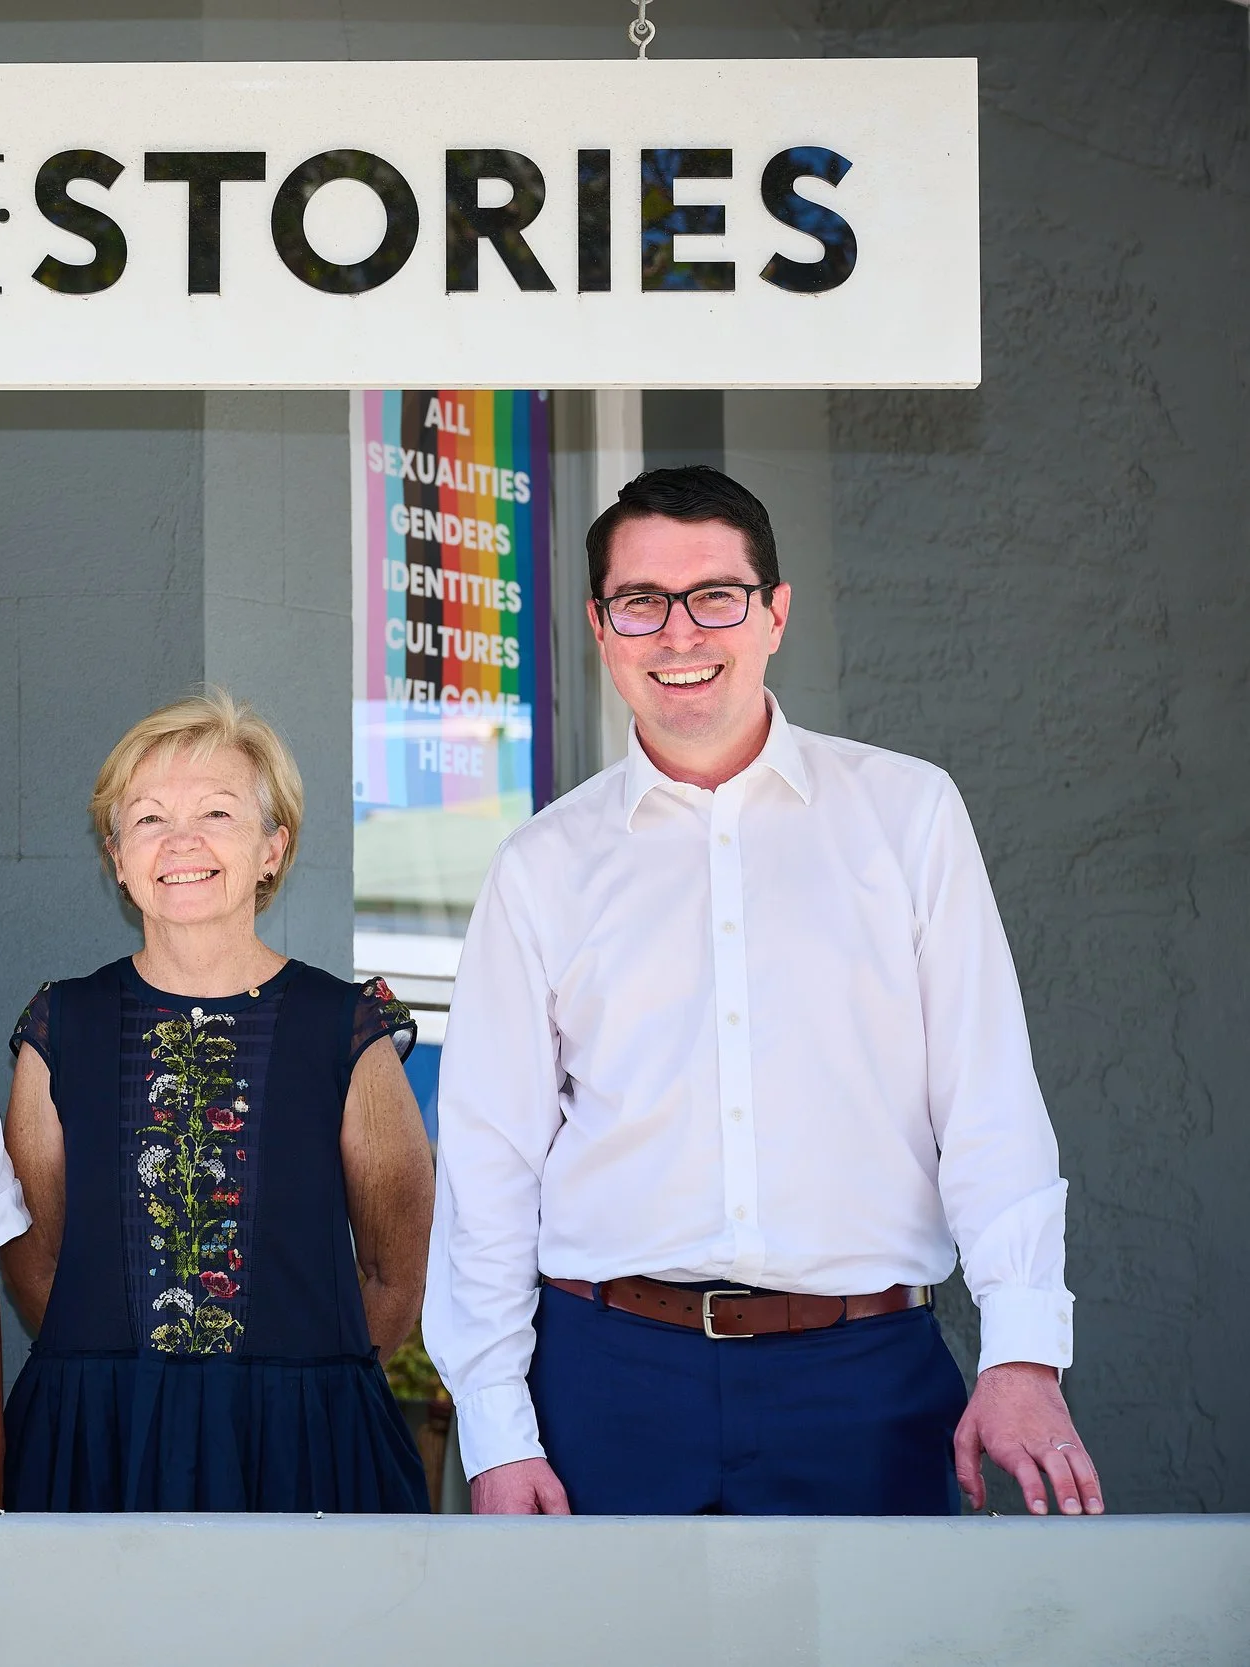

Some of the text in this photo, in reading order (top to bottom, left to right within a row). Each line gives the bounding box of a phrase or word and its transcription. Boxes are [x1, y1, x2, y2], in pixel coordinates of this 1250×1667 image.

[31, 148, 858, 295] STORIES
[423, 396, 470, 437] ALL
[367, 440, 531, 504] SEXUALITIES
[390, 503, 511, 556] GENDERS
[382, 558, 522, 614] IDENTITIES
[385, 618, 520, 670] CULTURES
[384, 675, 520, 724] WELCOME
[418, 738, 484, 777] HERE
